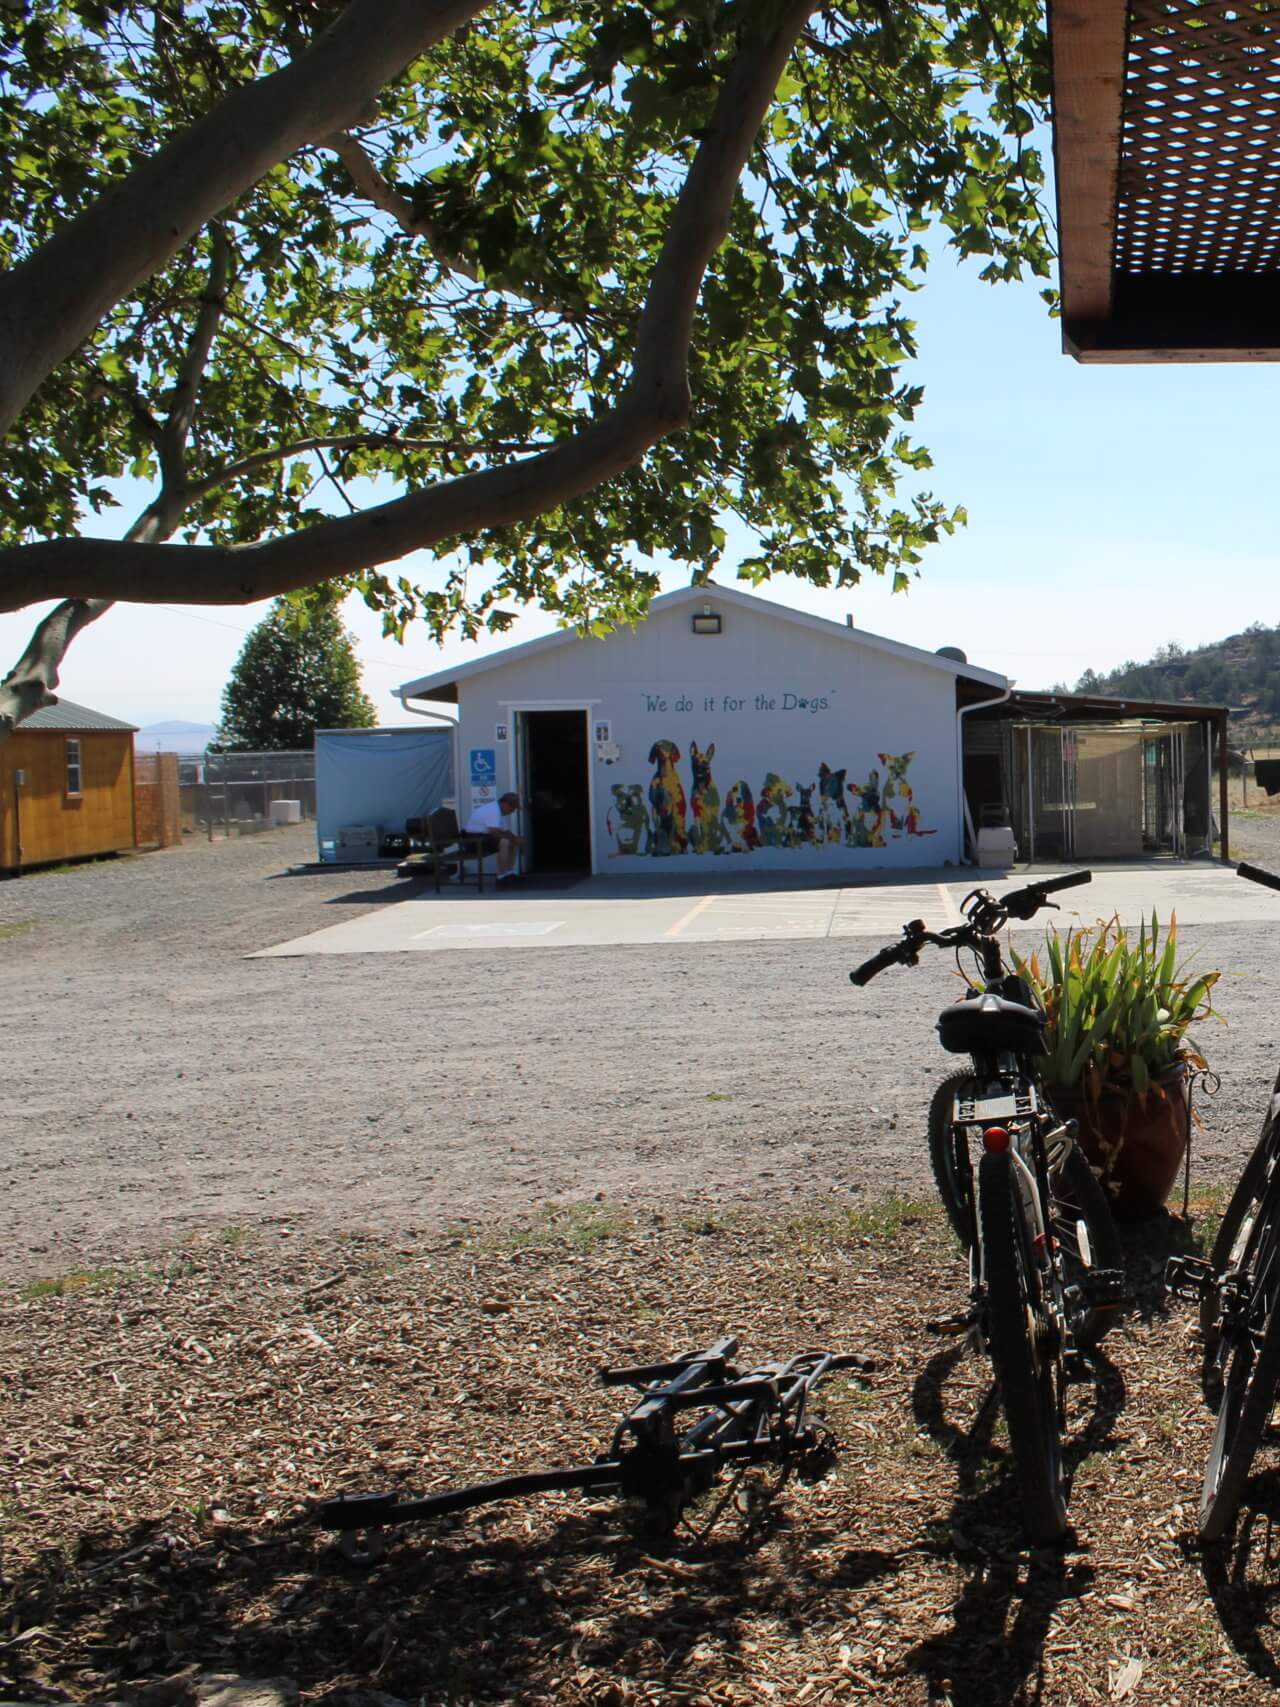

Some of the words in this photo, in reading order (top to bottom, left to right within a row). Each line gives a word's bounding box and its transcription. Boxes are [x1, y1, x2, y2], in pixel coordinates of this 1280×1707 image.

[674, 695, 694, 712] do
[703, 696, 715, 712] it
[721, 695, 746, 712] for
[754, 693, 776, 711] the
